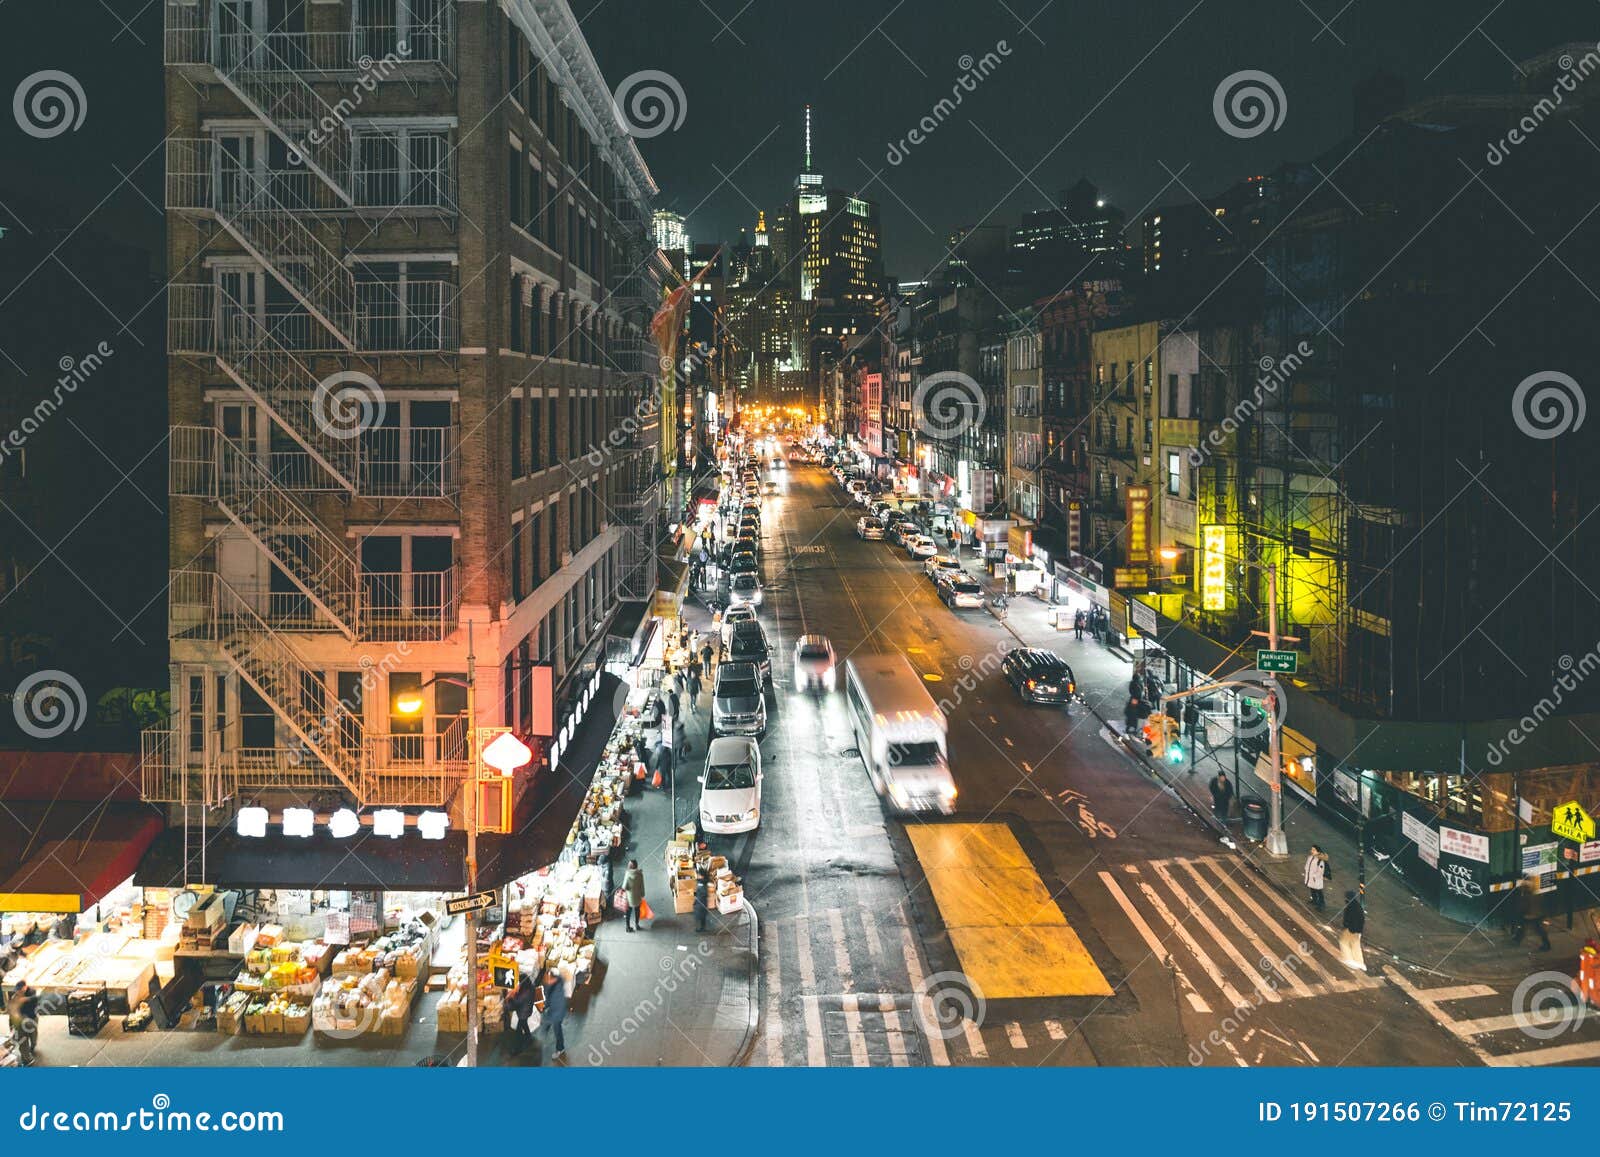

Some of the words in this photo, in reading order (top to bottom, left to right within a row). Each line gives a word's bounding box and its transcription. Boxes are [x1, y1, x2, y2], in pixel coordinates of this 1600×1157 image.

[1261, 653, 1294, 661] MANHATTAN
[453, 902, 466, 910] ONE
[474, 896, 488, 905] WAY
